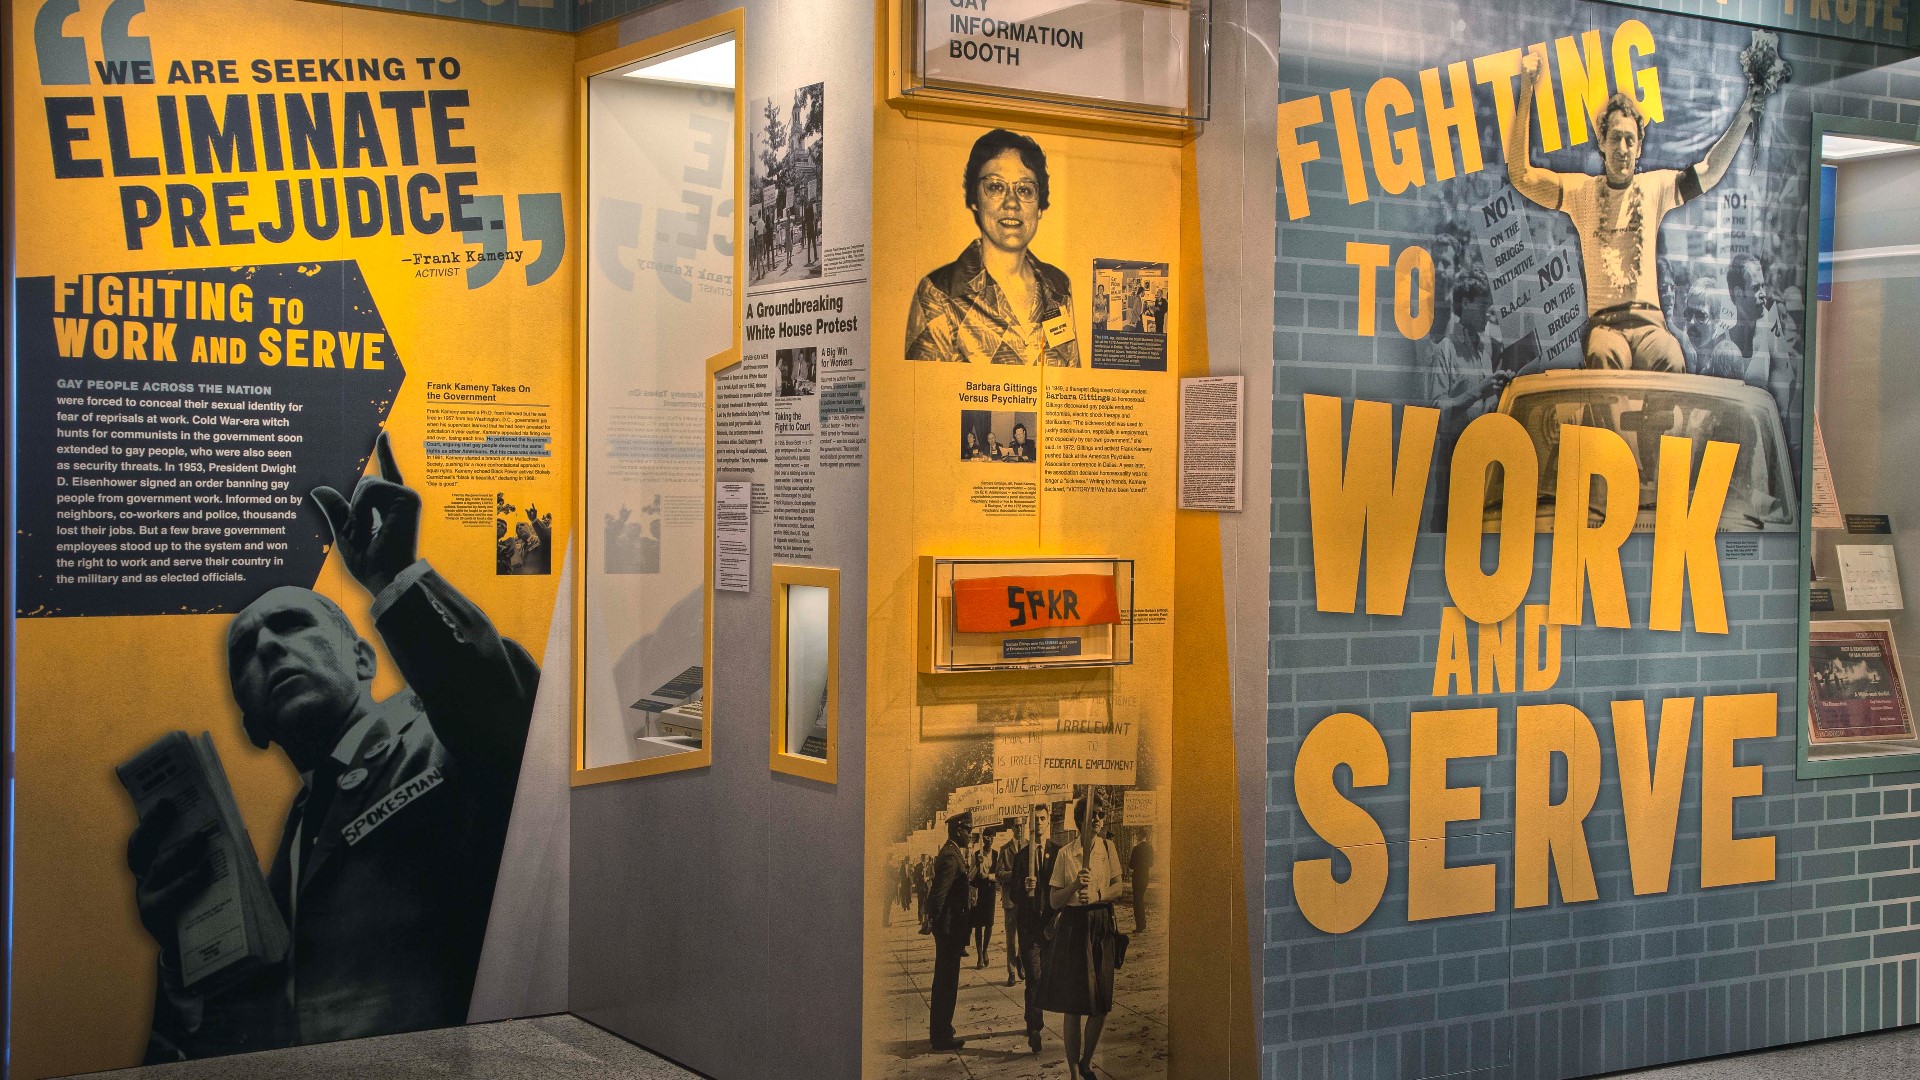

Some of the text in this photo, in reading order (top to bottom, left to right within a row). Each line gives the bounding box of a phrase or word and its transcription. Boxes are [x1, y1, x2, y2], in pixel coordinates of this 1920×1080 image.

[950, 14, 1084, 50] INFORMATION
[950, 39, 1020, 66] BOOTH
[95, 57, 461, 85] WE ARE SEEKING TO
[1277, 20, 1664, 221] FIGHTING
[44, 90, 477, 179] ELIMINATE
[1482, 190, 1516, 228] NO!
[1724, 193, 1747, 210] NO!
[119, 172, 504, 250] PREJUDICE.
[1490, 221, 1520, 248] ON THE
[465, 248, 523, 264] Kameny
[1494, 240, 1524, 268] BRIGGS
[415, 268, 460, 278] ACTIVIST
[1493, 255, 1534, 290] INITIATIVE
[1538, 248, 1570, 292] NO!
[1346, 242, 1436, 340] TO
[1543, 282, 1576, 314] ON THE
[53, 275, 304, 325] FIGHTING TO
[746, 296, 844, 320] A Groundbreaking
[1548, 304, 1580, 336] BRIGGS
[746, 315, 858, 342] White House Protest
[53, 318, 385, 370] WORK AND SERVE
[822, 347, 848, 358] A Big Win
[821, 357, 852, 368] for Workers
[57, 379, 271, 394] GAY PEOPLE ACROSS THE NATION
[428, 382, 530, 392] Frank Kameny Takes On
[966, 382, 1038, 395] Barbara Gittings
[87, 396, 122, 405] forced
[125, 398, 136, 406] to
[139, 399, 181, 407] conceal
[184, 399, 208, 408] their
[211, 401, 245, 409] sexual
[248, 401, 285, 412] identity
[288, 402, 303, 411] for
[443, 392, 496, 400] Government
[959, 394, 1037, 406] Versus Psychiatry
[1046, 392, 1110, 402] Barbara Gittings
[56, 411, 289, 426] fear of reprisals at work. Cold War-era witch
[775, 412, 802, 422] Taking the
[57, 428, 302, 442] hunts for communists in the government soon
[775, 422, 810, 433] Fight to Court
[57, 445, 108, 453] extended
[111, 446, 122, 454] to
[125, 447, 145, 456] gay
[148, 446, 187, 456] people,
[190, 447, 212, 455] who
[243, 448, 264, 456] also
[73, 461, 117, 472] security
[121, 462, 161, 470] threats.
[165, 462, 174, 470] In
[178, 462, 205, 472] 1953,
[209, 463, 258, 472] President
[261, 464, 296, 474] Dwight
[57, 477, 68, 485] D.
[72, 477, 137, 486] Eisenhower
[140, 478, 176, 488] signed
[195, 478, 223, 487] order
[226, 479, 267, 489] banning
[271, 481, 289, 490] gay
[57, 493, 94, 504] people
[97, 493, 123, 502] from
[126, 495, 191, 504] government
[194, 494, 222, 502] work.
[226, 494, 271, 503] Informed
[290, 495, 302, 505] by
[57, 509, 296, 520] neighbors, co-workers and police, thousands
[1303, 393, 1740, 634] WORK
[57, 526, 77, 534] lost
[80, 526, 106, 534] their
[109, 526, 135, 536] jobs.
[139, 526, 158, 534] But
[170, 525, 189, 534] few
[192, 525, 221, 534] brave
[224, 526, 285, 536] government
[56, 542, 116, 552] employees
[120, 541, 151, 550] stood
[154, 543, 168, 552] up
[170, 542, 181, 550] to
[184, 542, 201, 550] the
[204, 542, 241, 552] system
[244, 541, 263, 549] and
[56, 558, 74, 566] the
[78, 558, 103, 568] right
[106, 558, 117, 566] to
[120, 557, 147, 566] work
[150, 557, 170, 565] and
[205, 557, 229, 565] their
[231, 557, 271, 567] country
[274, 556, 283, 564] in
[56, 574, 74, 583] the
[77, 574, 118, 584] military
[121, 573, 141, 582] and
[160, 572, 198, 582] elected
[201, 572, 245, 581] officials.
[1008, 586, 1080, 627] SPKR
[1432, 604, 1562, 696] AND
[1056, 719, 1131, 736] IRRELEVANT
[1044, 758, 1134, 770] FEDERAL EMPLOYMENT
[1005, 778, 1020, 794] ANY
[344, 770, 440, 842] SPOKESMAN
[1293, 693, 1778, 934] SERVE
